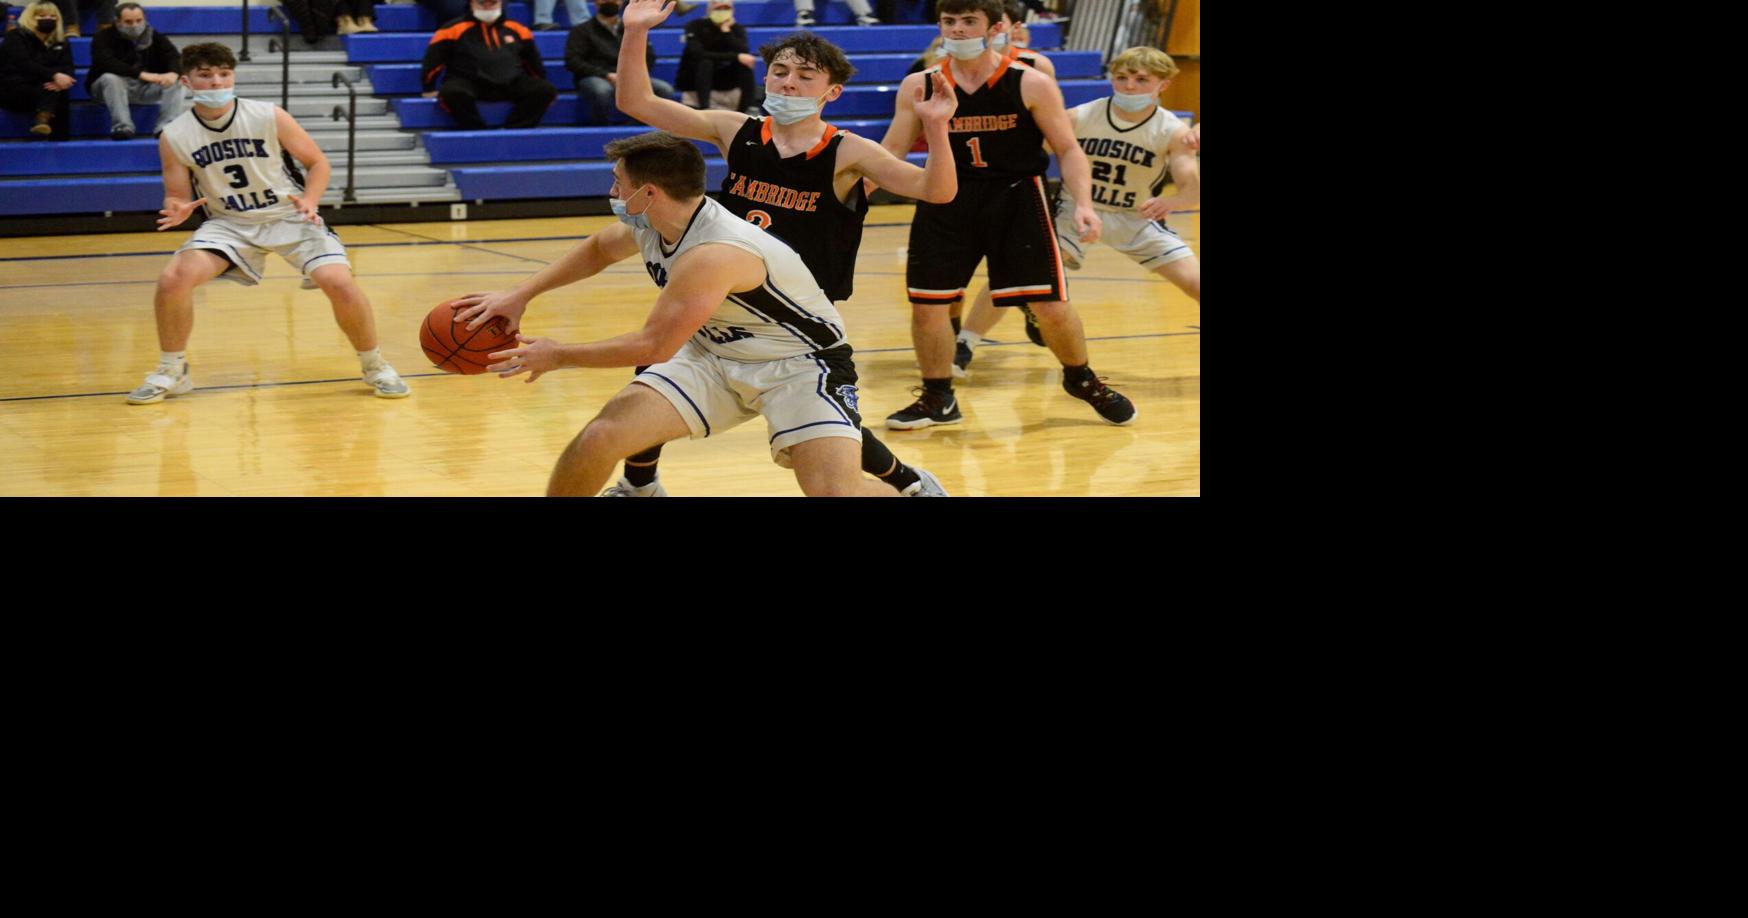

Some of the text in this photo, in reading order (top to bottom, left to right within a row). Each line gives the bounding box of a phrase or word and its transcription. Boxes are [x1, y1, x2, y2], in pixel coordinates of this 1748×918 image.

[948, 114, 1018, 133] MBRIDGE
[966, 137, 988, 168] 1
[223, 164, 249, 189] 3
[1091, 161, 1126, 186] 21
[729, 172, 821, 212] AMBRIDGE
[1091, 184, 1136, 208] ALLS
